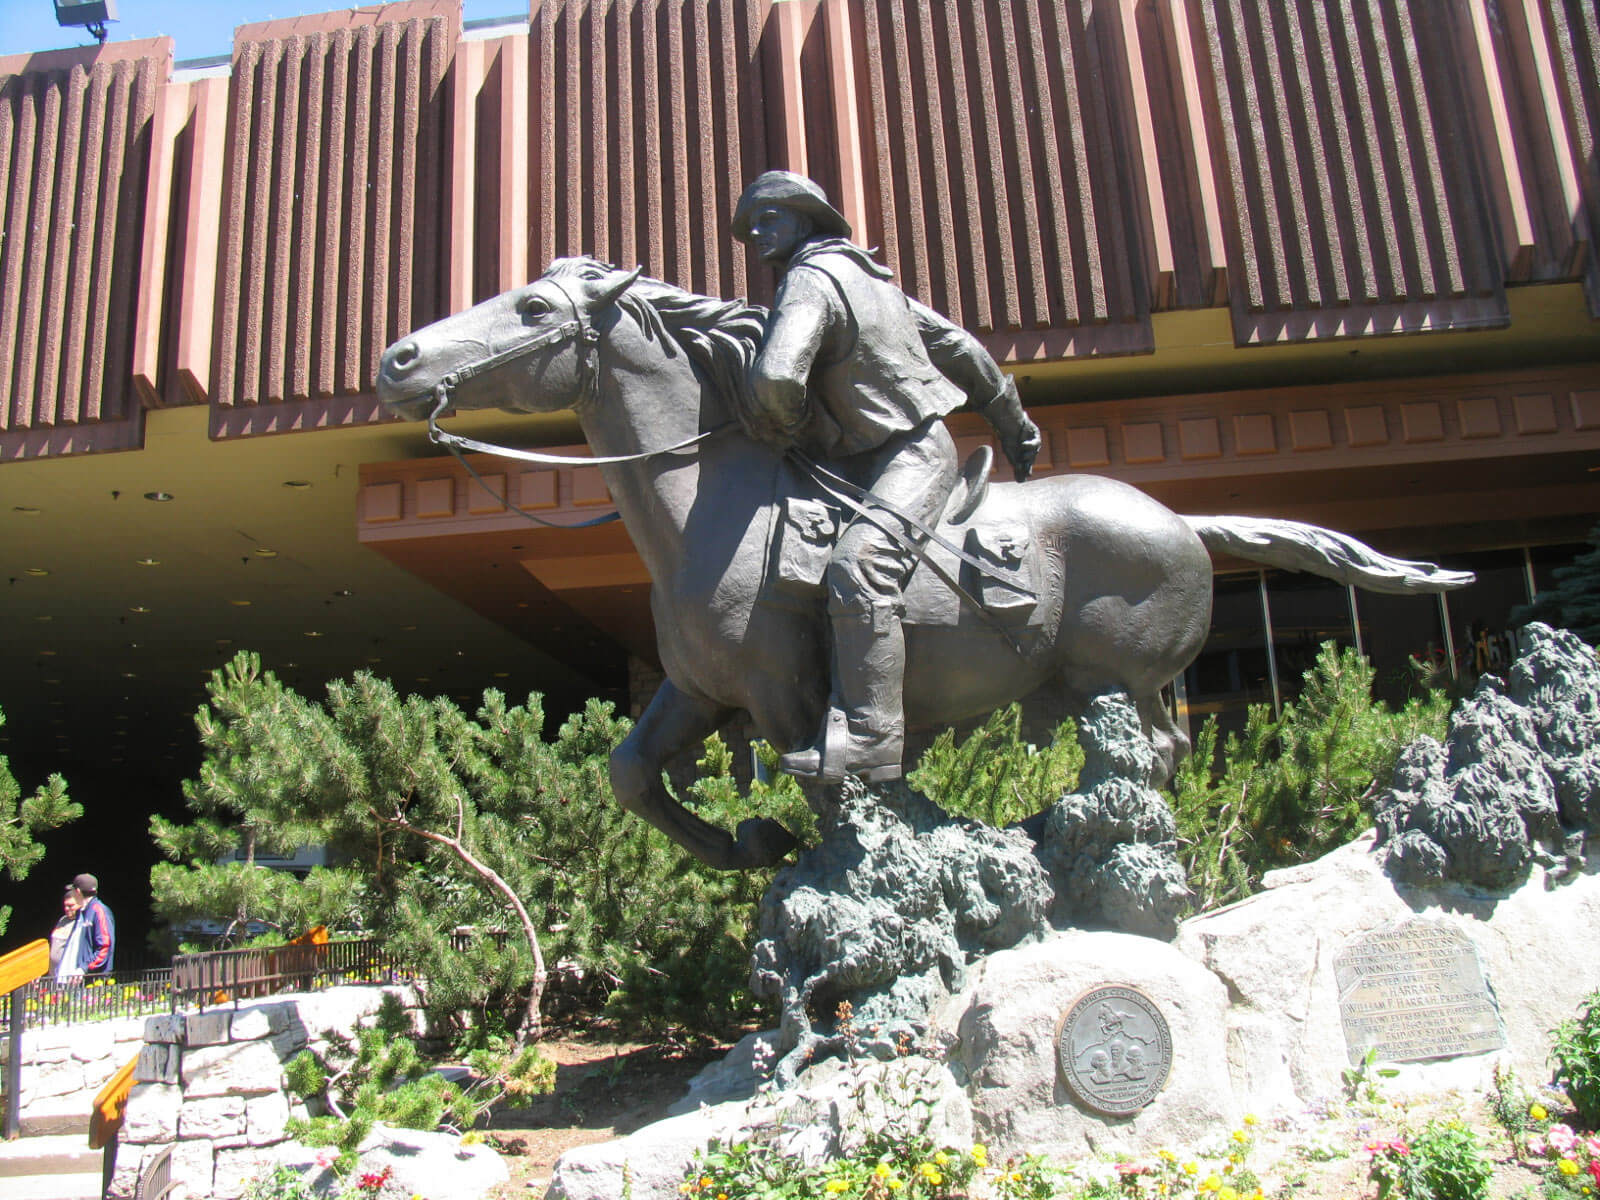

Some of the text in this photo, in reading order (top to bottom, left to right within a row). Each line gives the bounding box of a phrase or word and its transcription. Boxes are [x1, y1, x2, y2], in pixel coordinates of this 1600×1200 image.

[1348, 936, 1454, 956] THE PONY EXPRESS
[1353, 961, 1401, 975] WINNING
[1429, 957, 1457, 967] WEST
[1360, 976, 1399, 988] ERECTED
[1388, 982, 1441, 997] HARRAH'S
[1346, 1000, 1385, 1013] WILLIAM
[1439, 990, 1485, 1003] PRESIDENT
[1065, 1012, 1078, 1033] PONY
[1077, 990, 1109, 1014] EXPRESS
[1425, 1025, 1461, 1037] STATION
